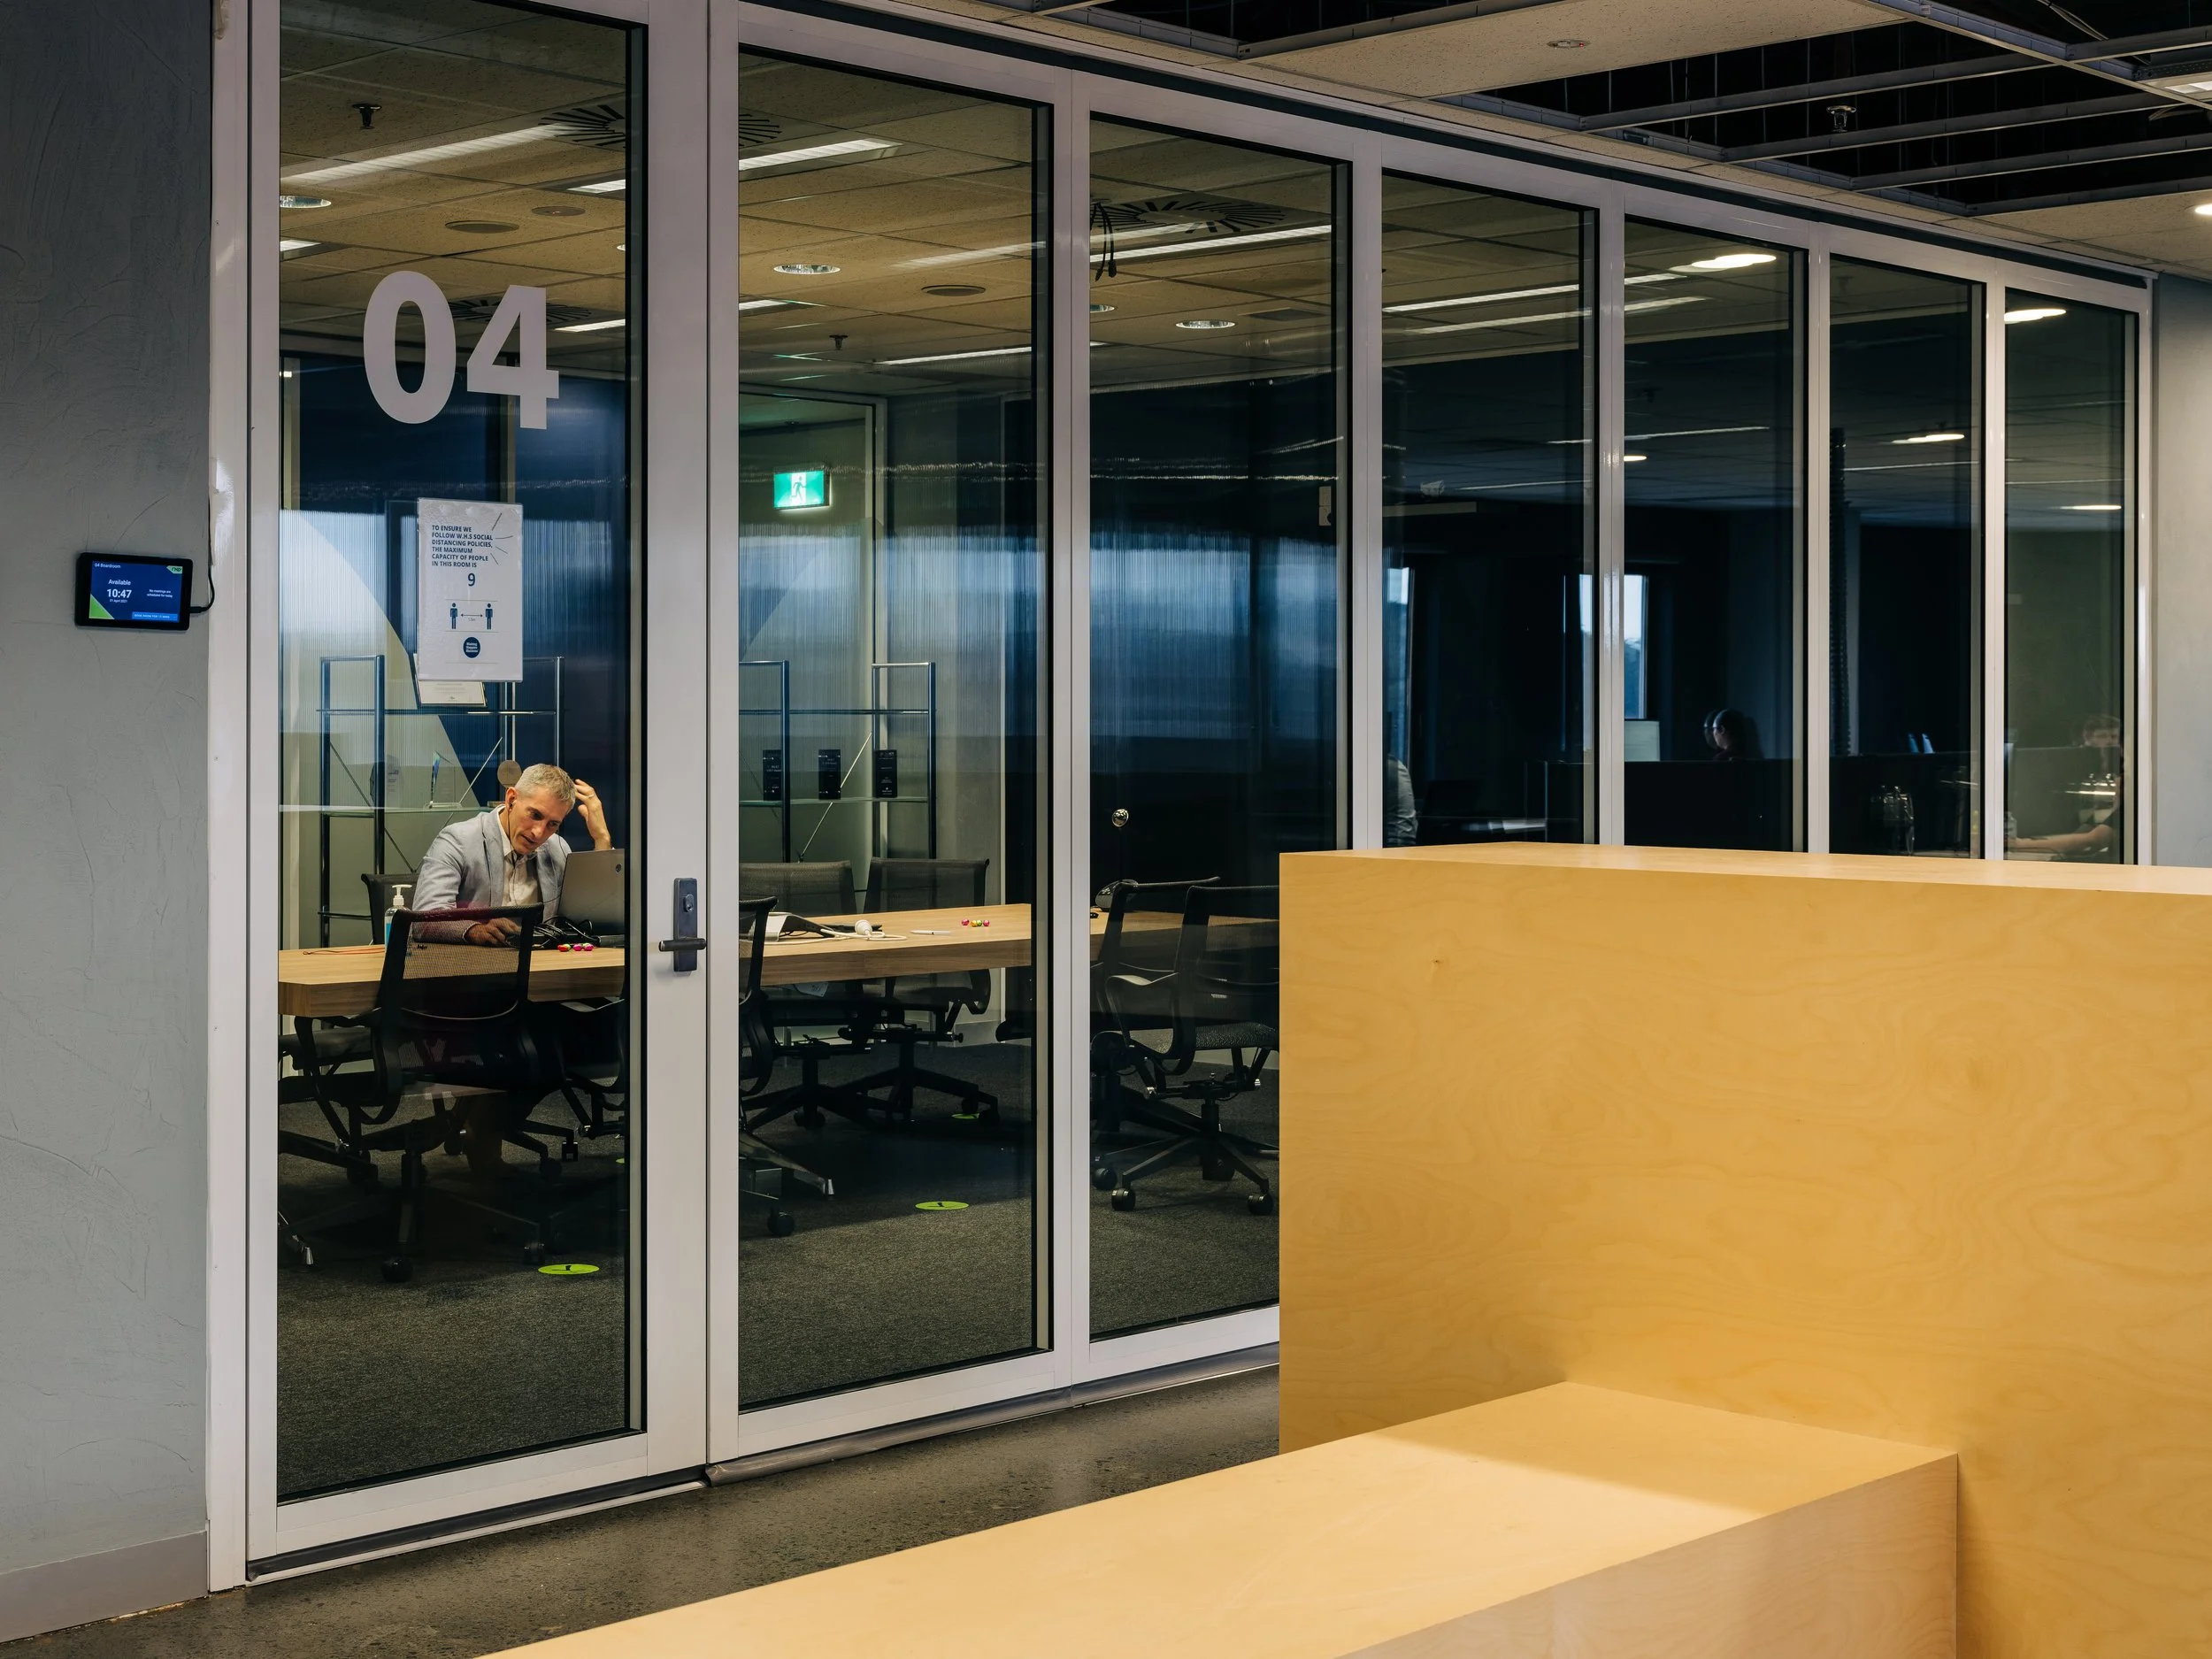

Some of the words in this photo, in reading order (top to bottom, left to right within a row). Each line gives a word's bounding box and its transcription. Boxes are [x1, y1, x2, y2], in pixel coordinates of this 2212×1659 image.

[363, 270, 560, 430] 04
[467, 572, 476, 587] 9
[106, 588, 133, 598] 10:47
